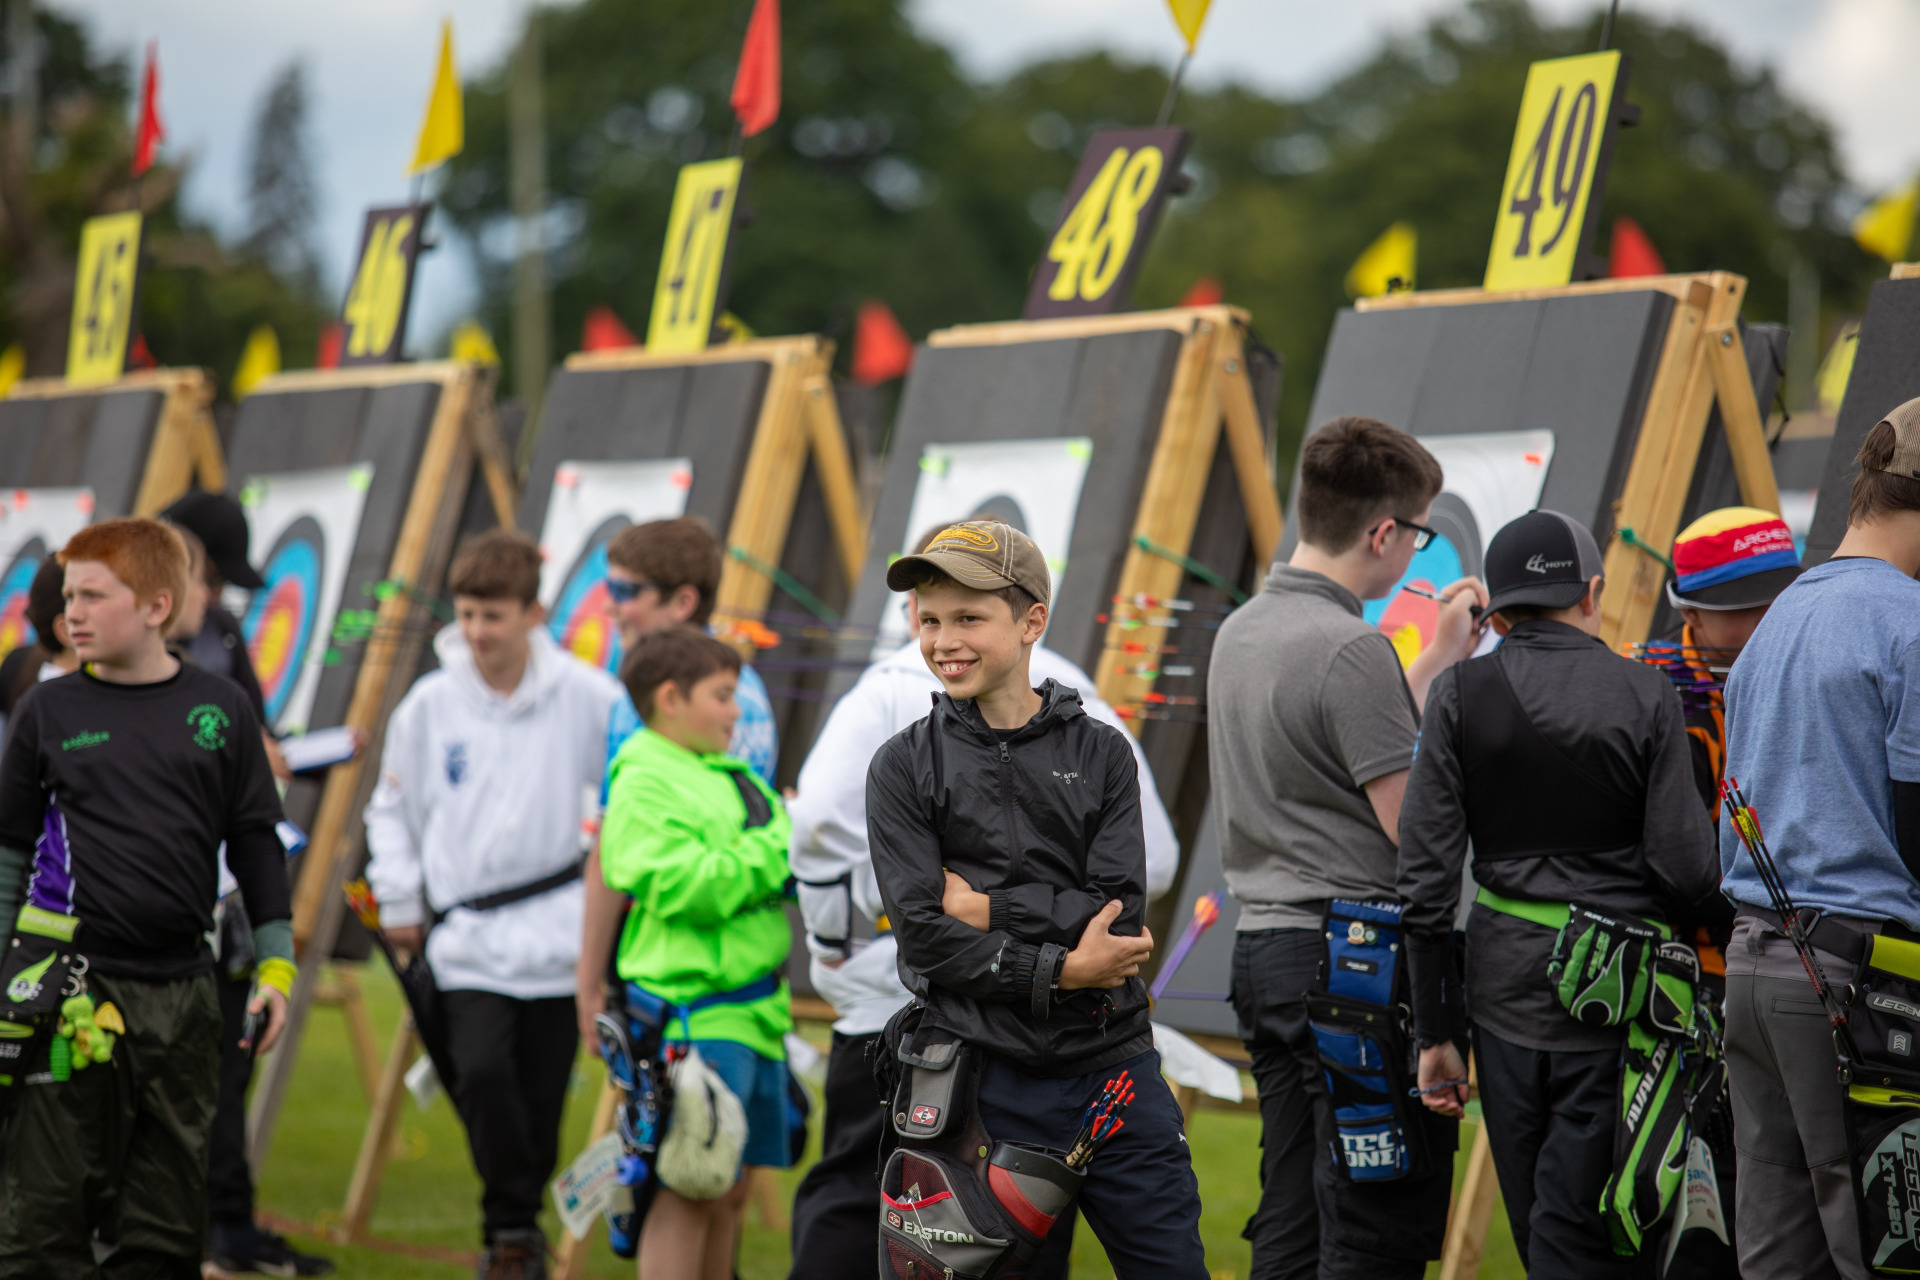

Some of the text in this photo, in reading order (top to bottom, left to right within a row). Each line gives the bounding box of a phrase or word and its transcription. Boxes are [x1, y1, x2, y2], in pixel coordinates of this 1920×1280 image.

[1047, 145, 1164, 302] 48
[1510, 81, 1596, 259] 49
[84, 240, 127, 361] 45
[344, 214, 415, 357] 46
[664, 186, 735, 329] 47
[1545, 560, 1573, 569] HOYT
[1626, 1038, 1671, 1134] AVALON
[904, 1221, 974, 1244] EASTON
[1880, 1154, 1904, 1236] XT-420
